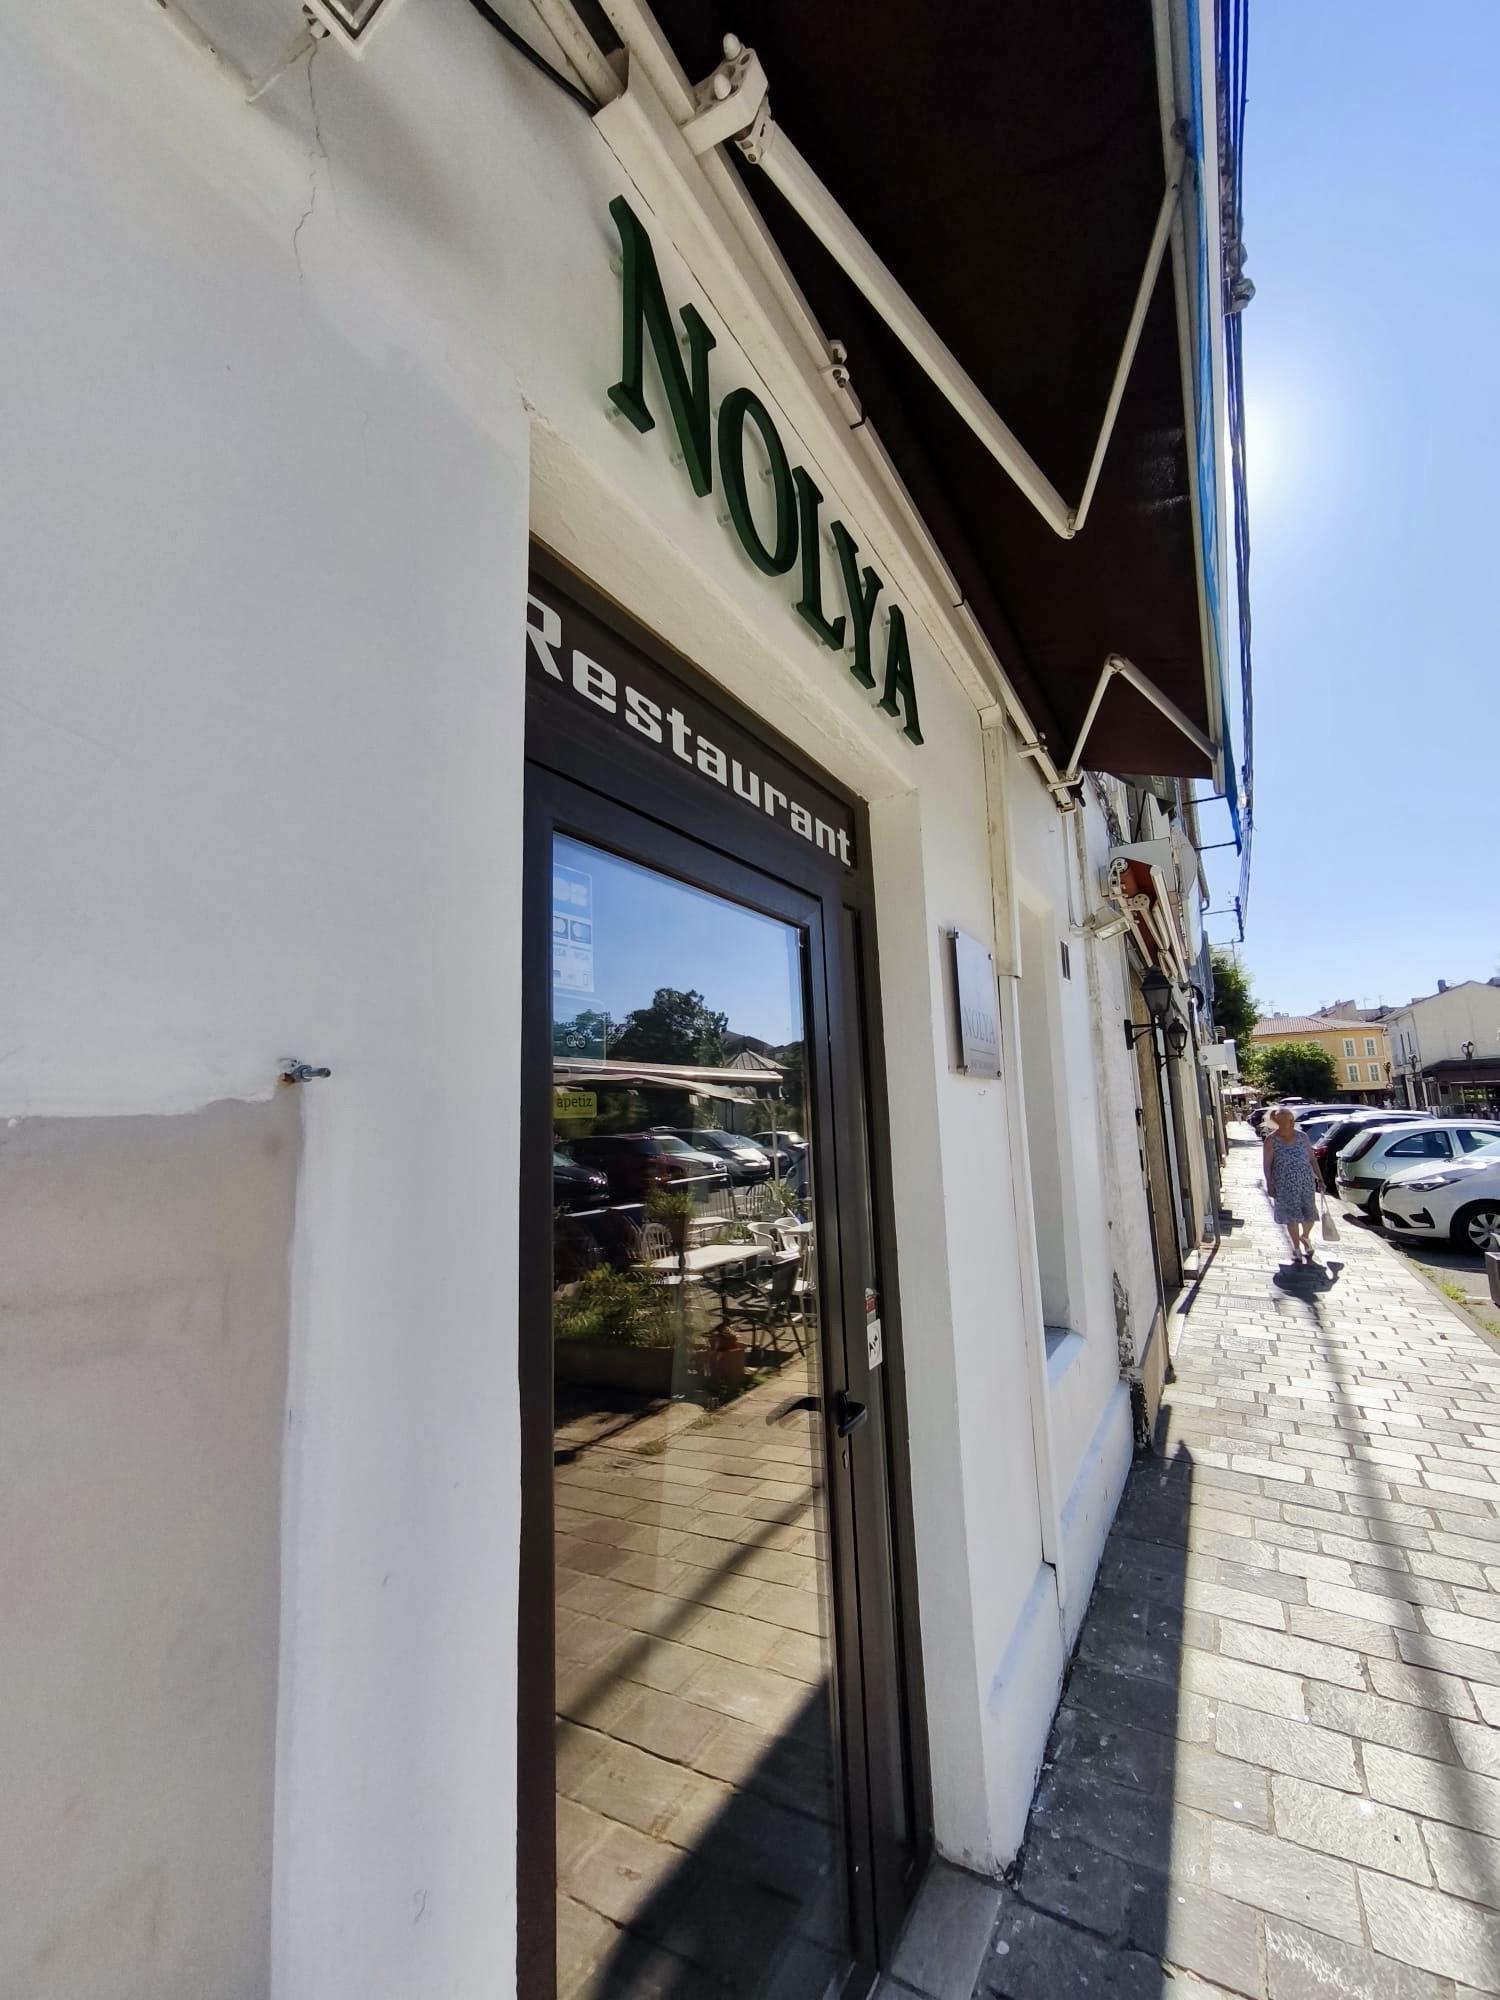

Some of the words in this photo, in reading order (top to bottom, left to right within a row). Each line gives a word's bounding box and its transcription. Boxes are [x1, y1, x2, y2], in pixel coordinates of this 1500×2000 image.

[606, 194, 923, 745] NOLYA
[526, 592, 852, 868] Restaurant
[556, 1093, 593, 1111] apetiz
[962, 1003, 996, 1045] NOLYA
